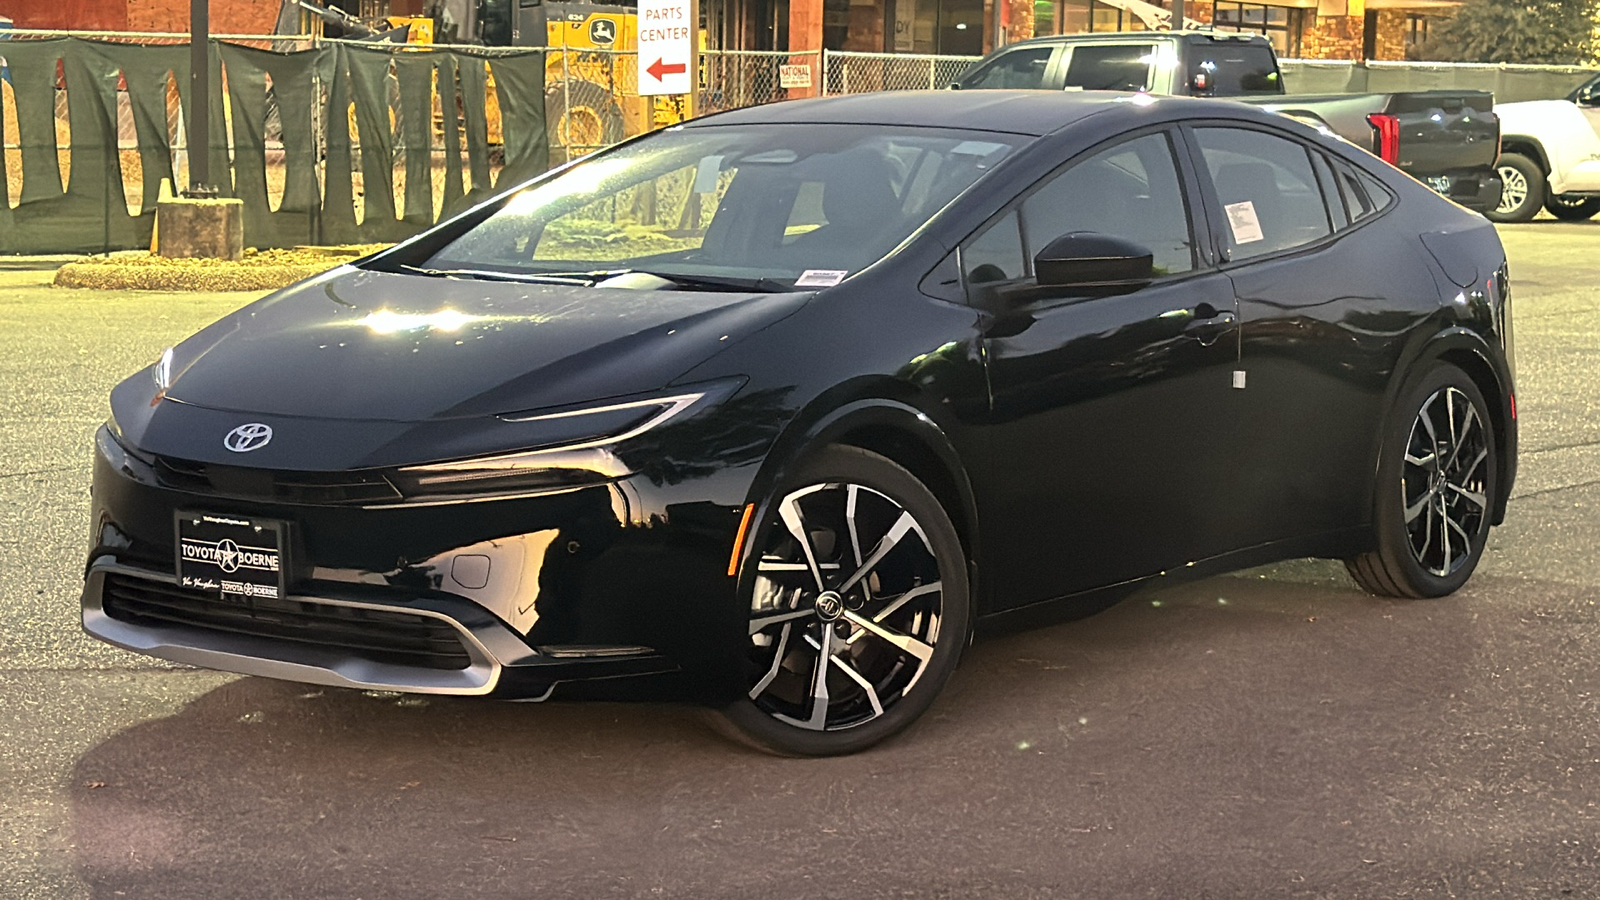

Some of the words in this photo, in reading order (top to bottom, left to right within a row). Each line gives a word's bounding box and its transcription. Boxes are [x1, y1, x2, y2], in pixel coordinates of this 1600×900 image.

[646, 7, 682, 20] PARTS
[640, 27, 688, 42] CENTER
[781, 66, 809, 76] NATIONAL
[182, 544, 221, 561] TOYOTA
[238, 552, 279, 567] BOERNE
